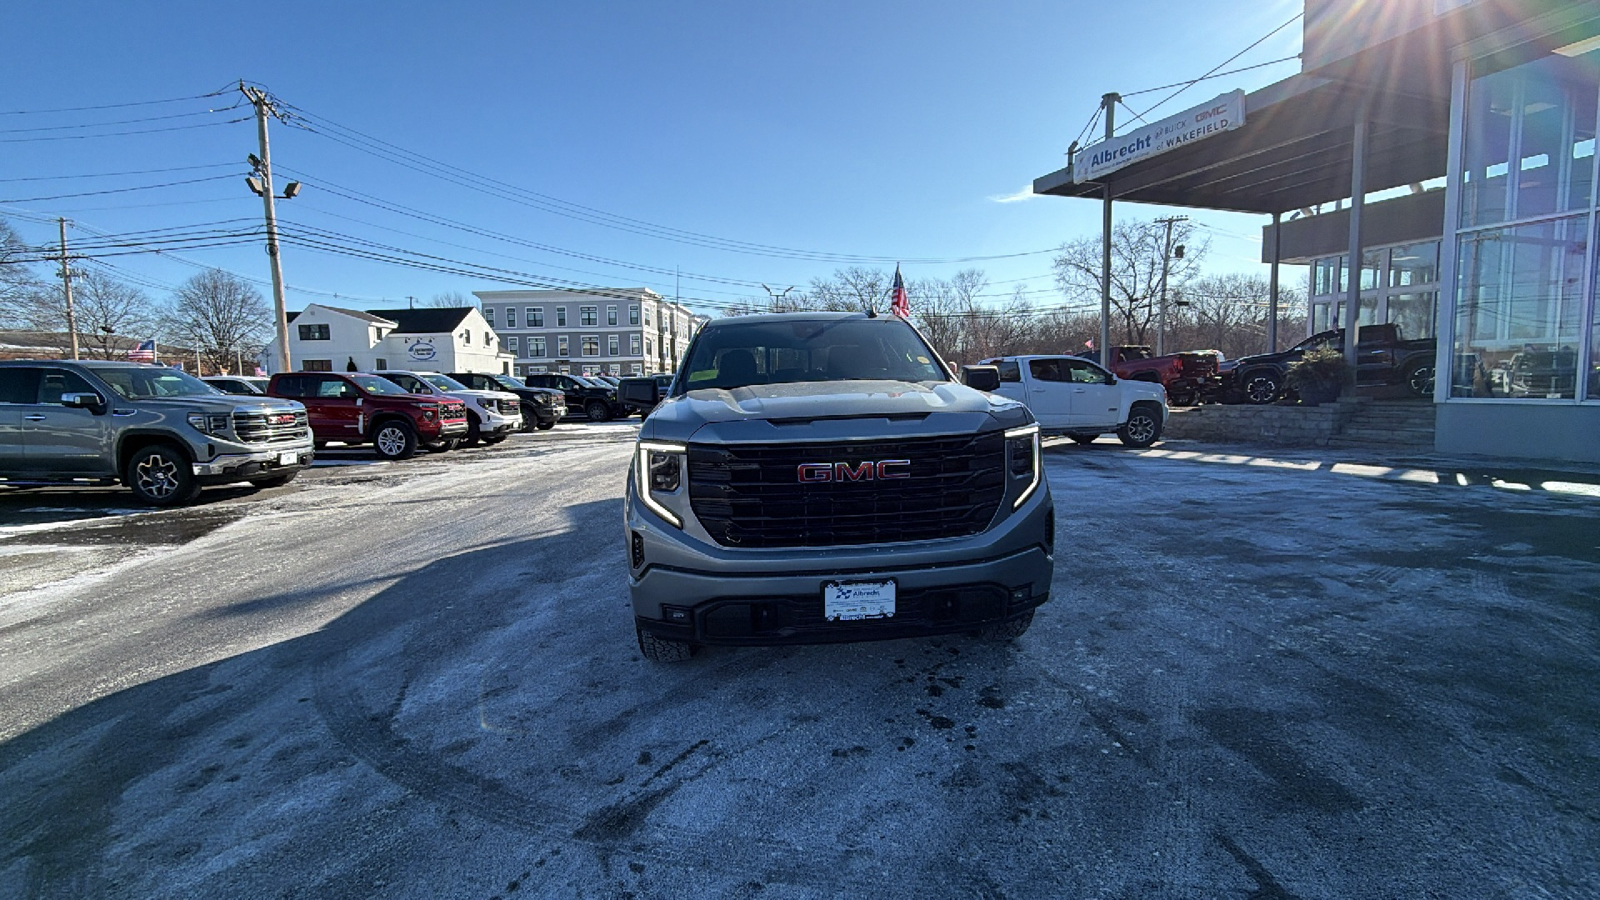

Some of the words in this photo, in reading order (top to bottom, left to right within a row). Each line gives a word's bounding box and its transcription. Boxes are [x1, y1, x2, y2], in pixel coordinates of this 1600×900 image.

[1156, 141, 1164, 151] of
[1166, 119, 1229, 147] WAKEFIELD
[1165, 119, 1187, 135] BUICK
[1195, 103, 1228, 123] GMC
[1091, 134, 1152, 167] Albrecht
[797, 459, 911, 483] GMC
